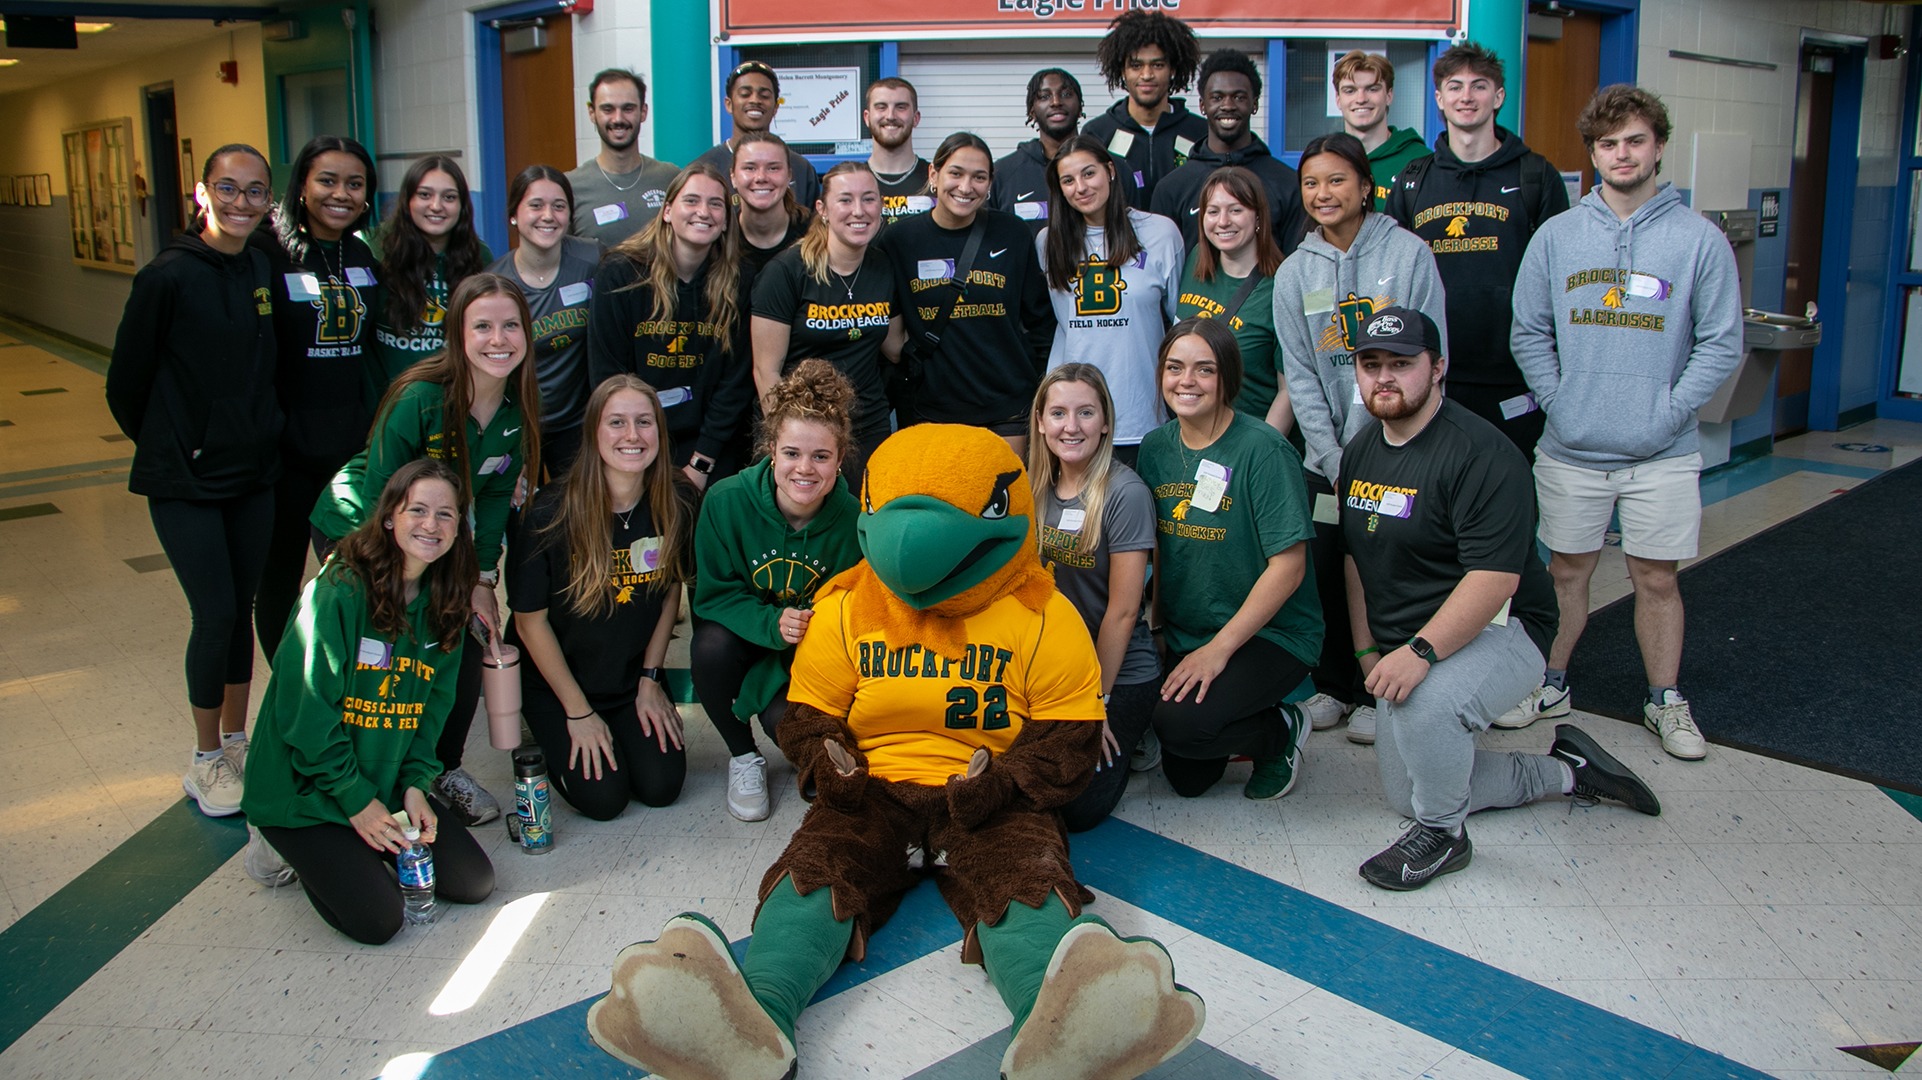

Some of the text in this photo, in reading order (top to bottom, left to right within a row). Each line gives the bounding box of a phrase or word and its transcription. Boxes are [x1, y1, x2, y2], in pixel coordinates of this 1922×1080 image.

[809, 89, 849, 127] Eagle Pride
[1414, 202, 1509, 229] BROCKPORT
[910, 269, 1006, 294] BROORT
[1565, 267, 1673, 299] BROCK
[807, 302, 891, 320] BROCKPORT
[917, 303, 1006, 321] ASETBALL
[1179, 293, 1244, 331] BROCKPT
[1570, 308, 1665, 333] LACROSSE
[634, 320, 724, 338] BROCKPOR
[805, 317, 855, 330] GOLDEN
[1069, 318, 1130, 329] FIELD HOCKEY
[307, 345, 363, 358] BASKEBLL
[1153, 483, 1233, 511] BROCKT
[1177, 522, 1227, 541] HOCKEY
[1050, 547, 1096, 569] EAGLES
[344, 696, 378, 714] COSS
[945, 684, 1011, 730] 22
[342, 711, 379, 729] TRACK
[383, 717, 393, 729] &
